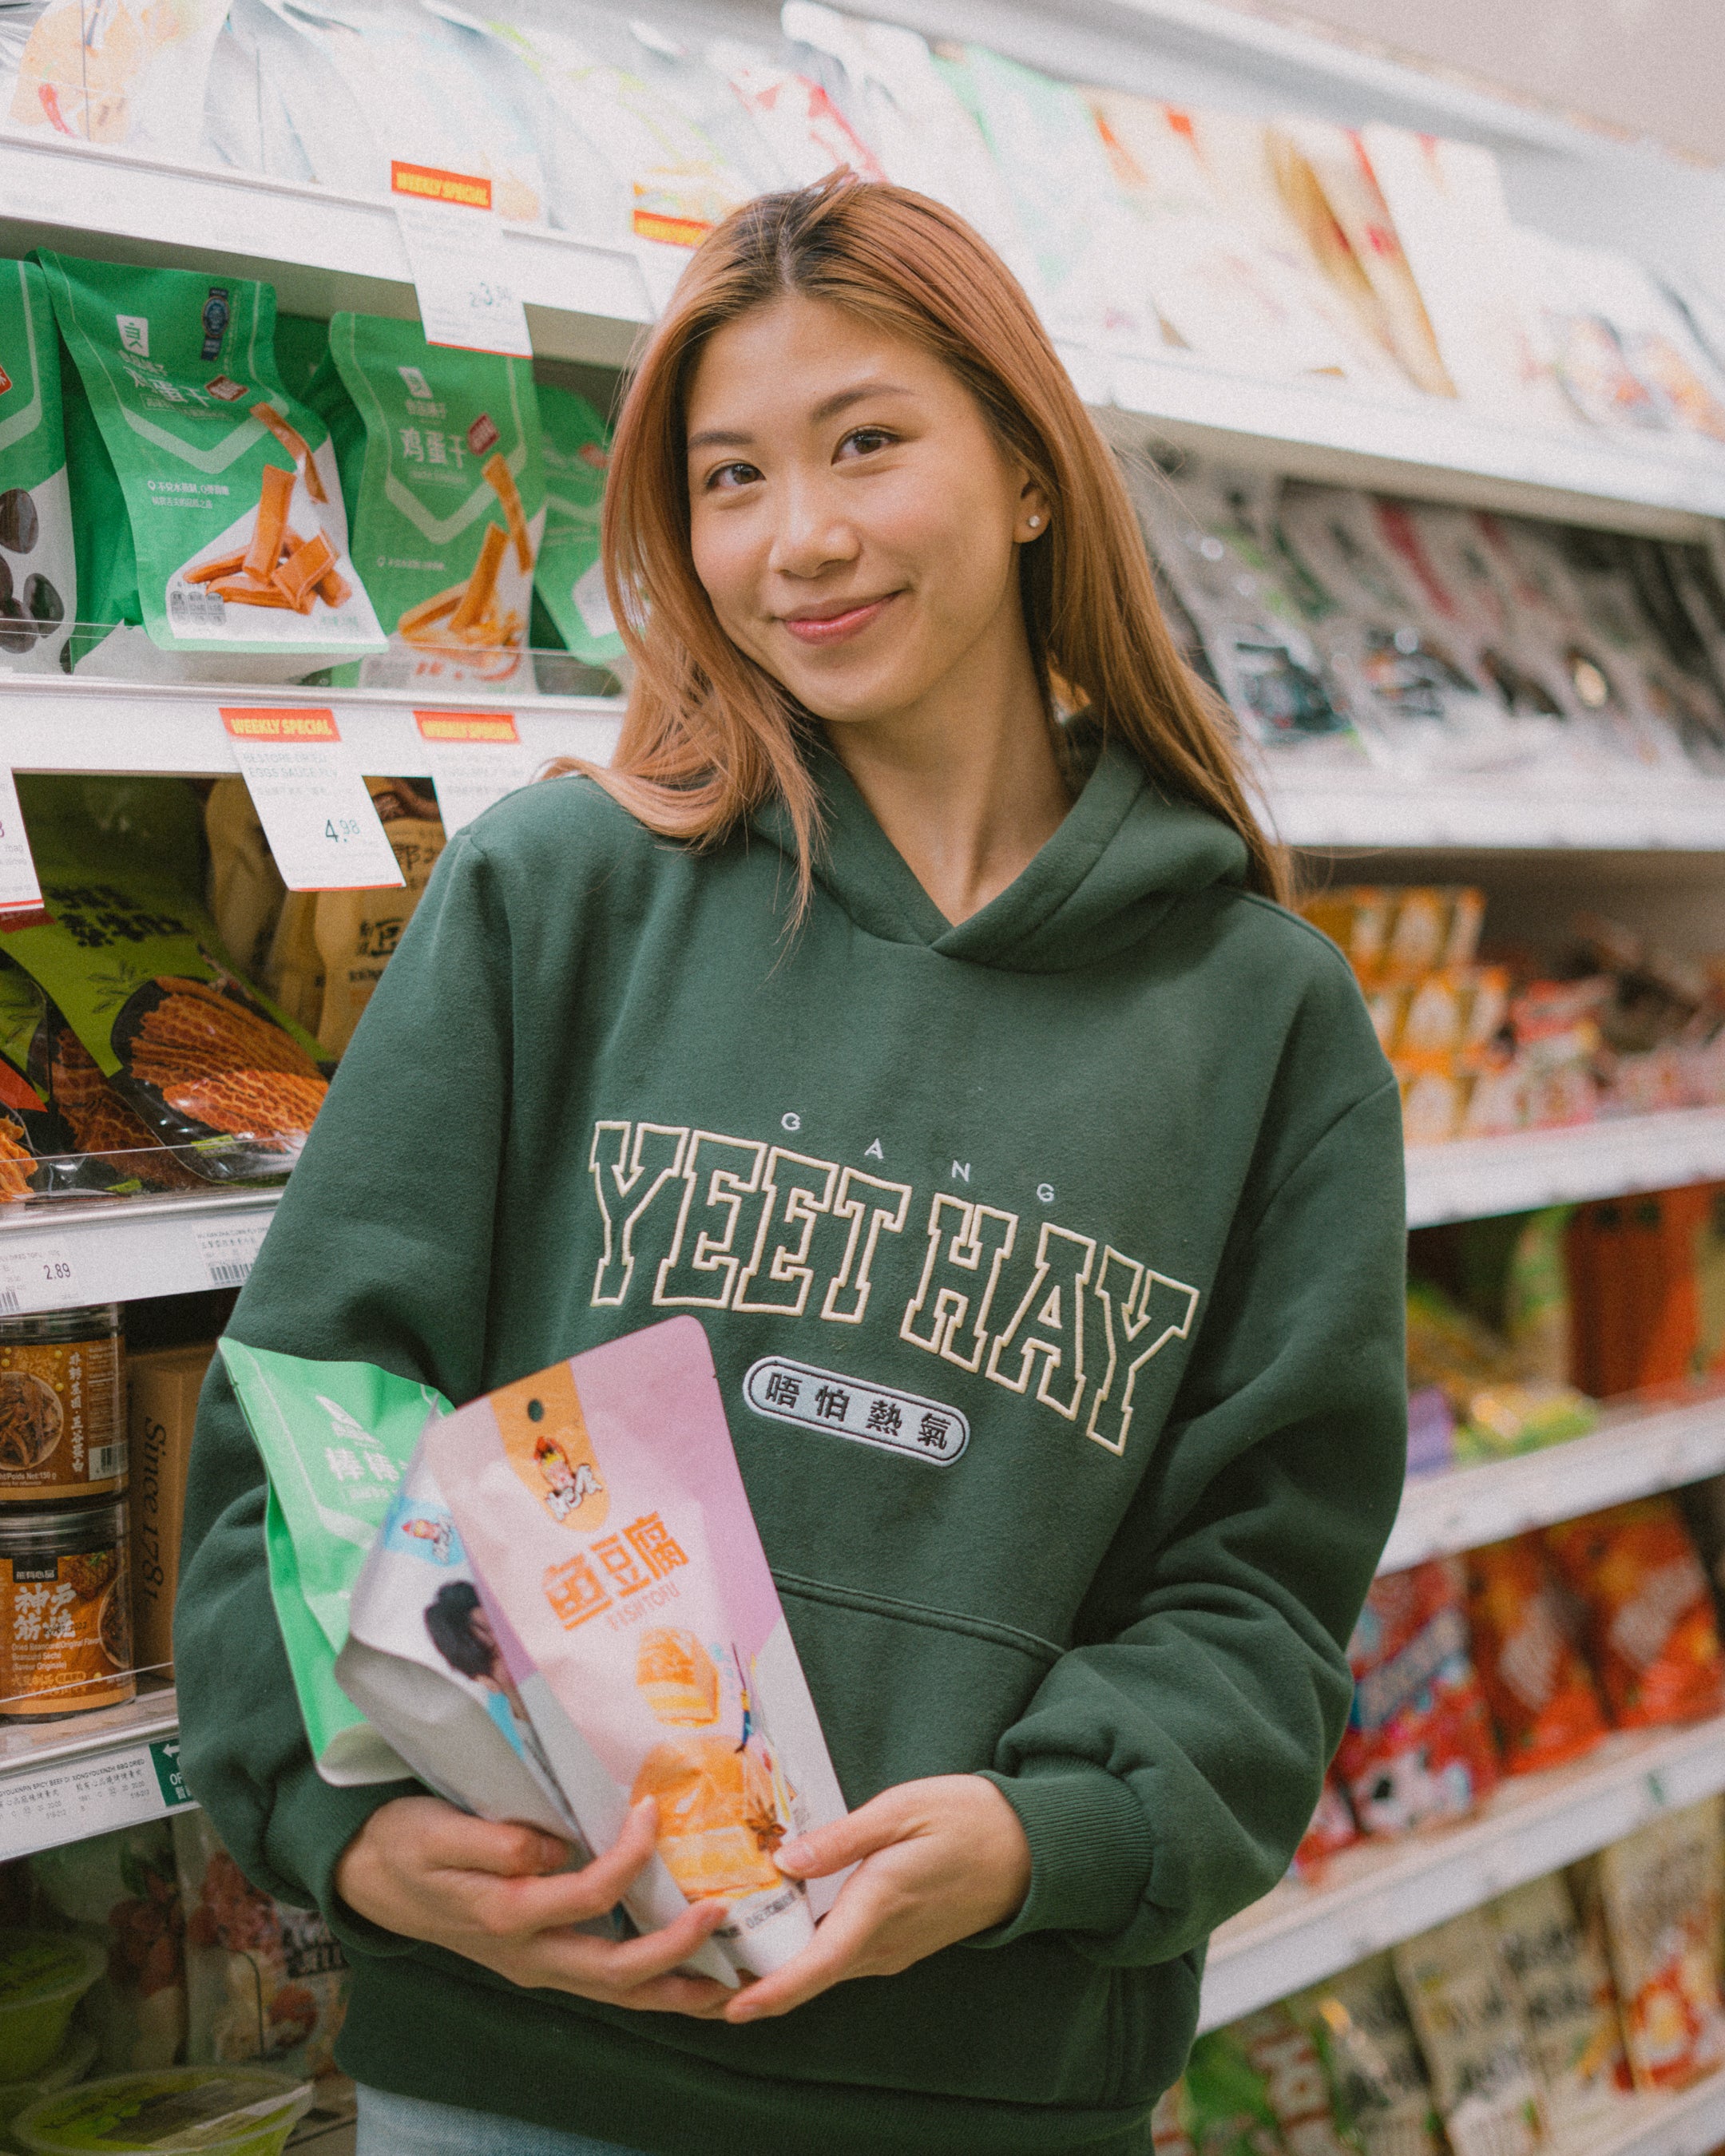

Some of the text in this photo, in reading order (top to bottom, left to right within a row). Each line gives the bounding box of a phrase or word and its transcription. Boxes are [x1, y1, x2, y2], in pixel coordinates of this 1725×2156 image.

[231, 719, 333, 735] WEEKLY SPECIAL
[325, 819, 361, 843] 4.98
[781, 1112, 1055, 1203] GANG
[43, 1262, 71, 1280] 2.89
[589, 1120, 1200, 1457] YEET HAY
[765, 1371, 953, 1451] 唔怕熱氣
[144, 1417, 167, 1513] Since
[325, 1447, 409, 1482] 棒棒
[542, 1511, 690, 1631] 鱼豆腐
[129, 1758, 145, 1767] DRIED
[33, 1781, 48, 1789] SPICY
[49, 1778, 64, 1787] BEEF
